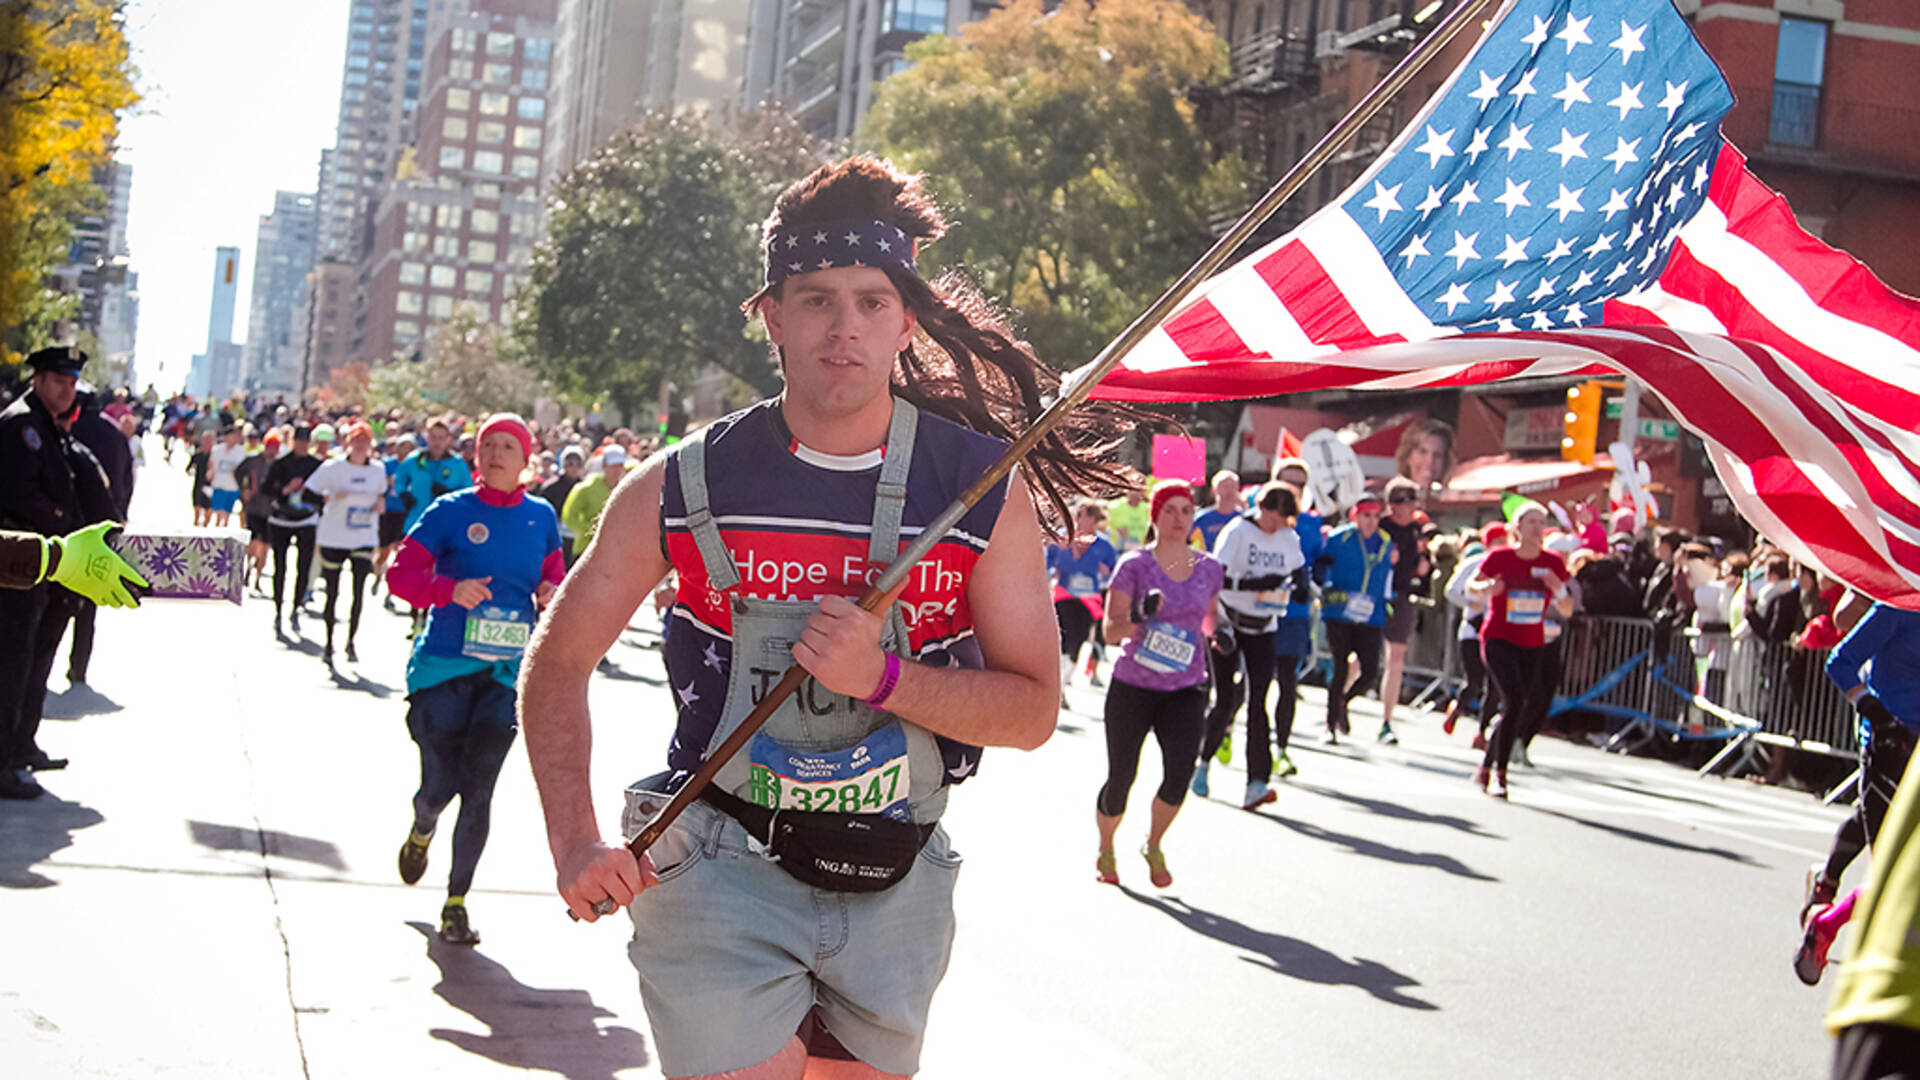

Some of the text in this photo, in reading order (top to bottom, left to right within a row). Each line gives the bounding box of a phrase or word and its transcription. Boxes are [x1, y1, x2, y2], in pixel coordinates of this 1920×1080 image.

[730, 548, 828, 595] Hope
[843, 556, 883, 587] Fo
[917, 559, 963, 592] The
[791, 764, 901, 813] 32847
